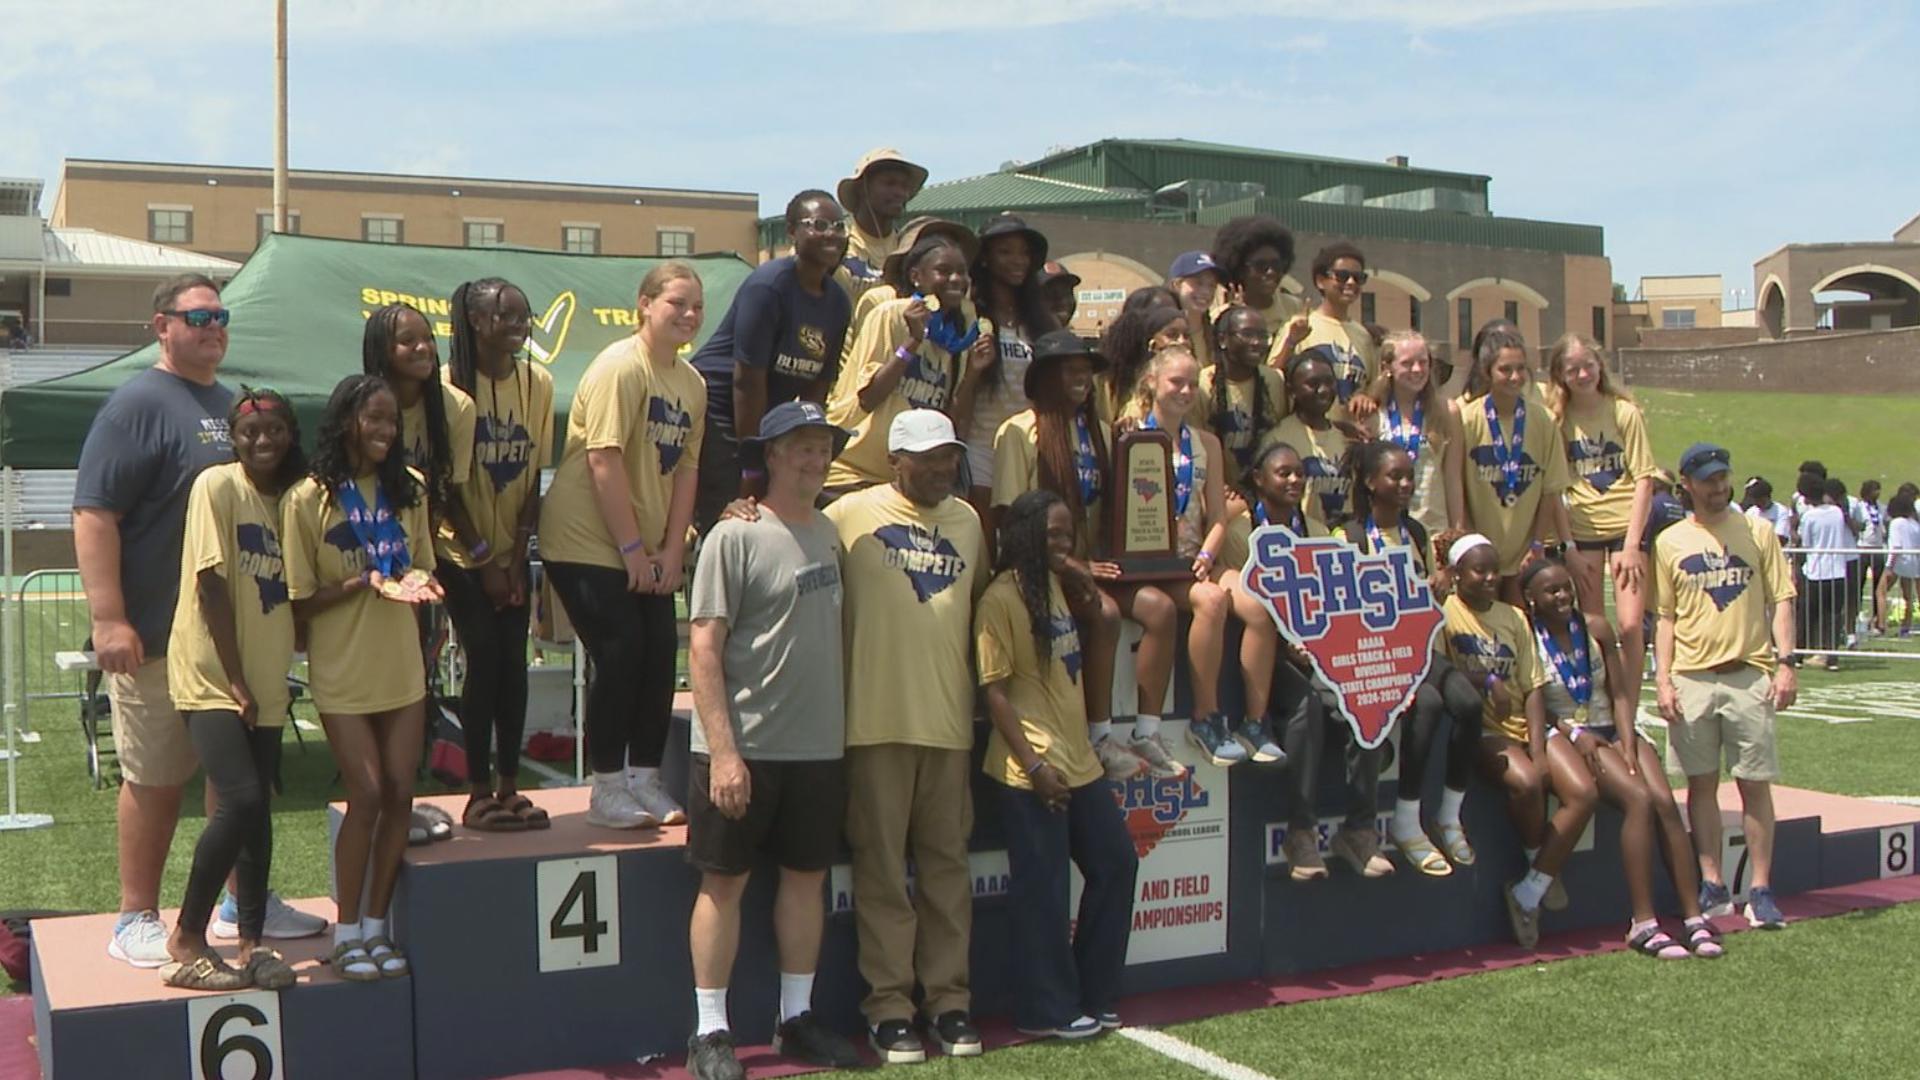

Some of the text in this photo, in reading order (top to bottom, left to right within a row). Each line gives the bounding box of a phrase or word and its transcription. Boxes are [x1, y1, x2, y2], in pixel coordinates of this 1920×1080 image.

[361, 288, 451, 316] SPRIN
[881, 548, 963, 577] COMPETE
[1257, 532, 1430, 638] SCHSL
[1686, 566, 1751, 592] COMPETE
[1332, 645, 1413, 668] GIRLS TRACK & FIELD
[1340, 672, 1413, 694] STATE CHAMPIONS
[1354, 662, 1391, 679] DIVISION
[1356, 688, 1402, 706] 2024-2025
[1886, 832, 1908, 872] 8
[1141, 875, 1210, 901] AND FIELD
[550, 871, 608, 953] 4
[200, 1003, 273, 1080] 6
